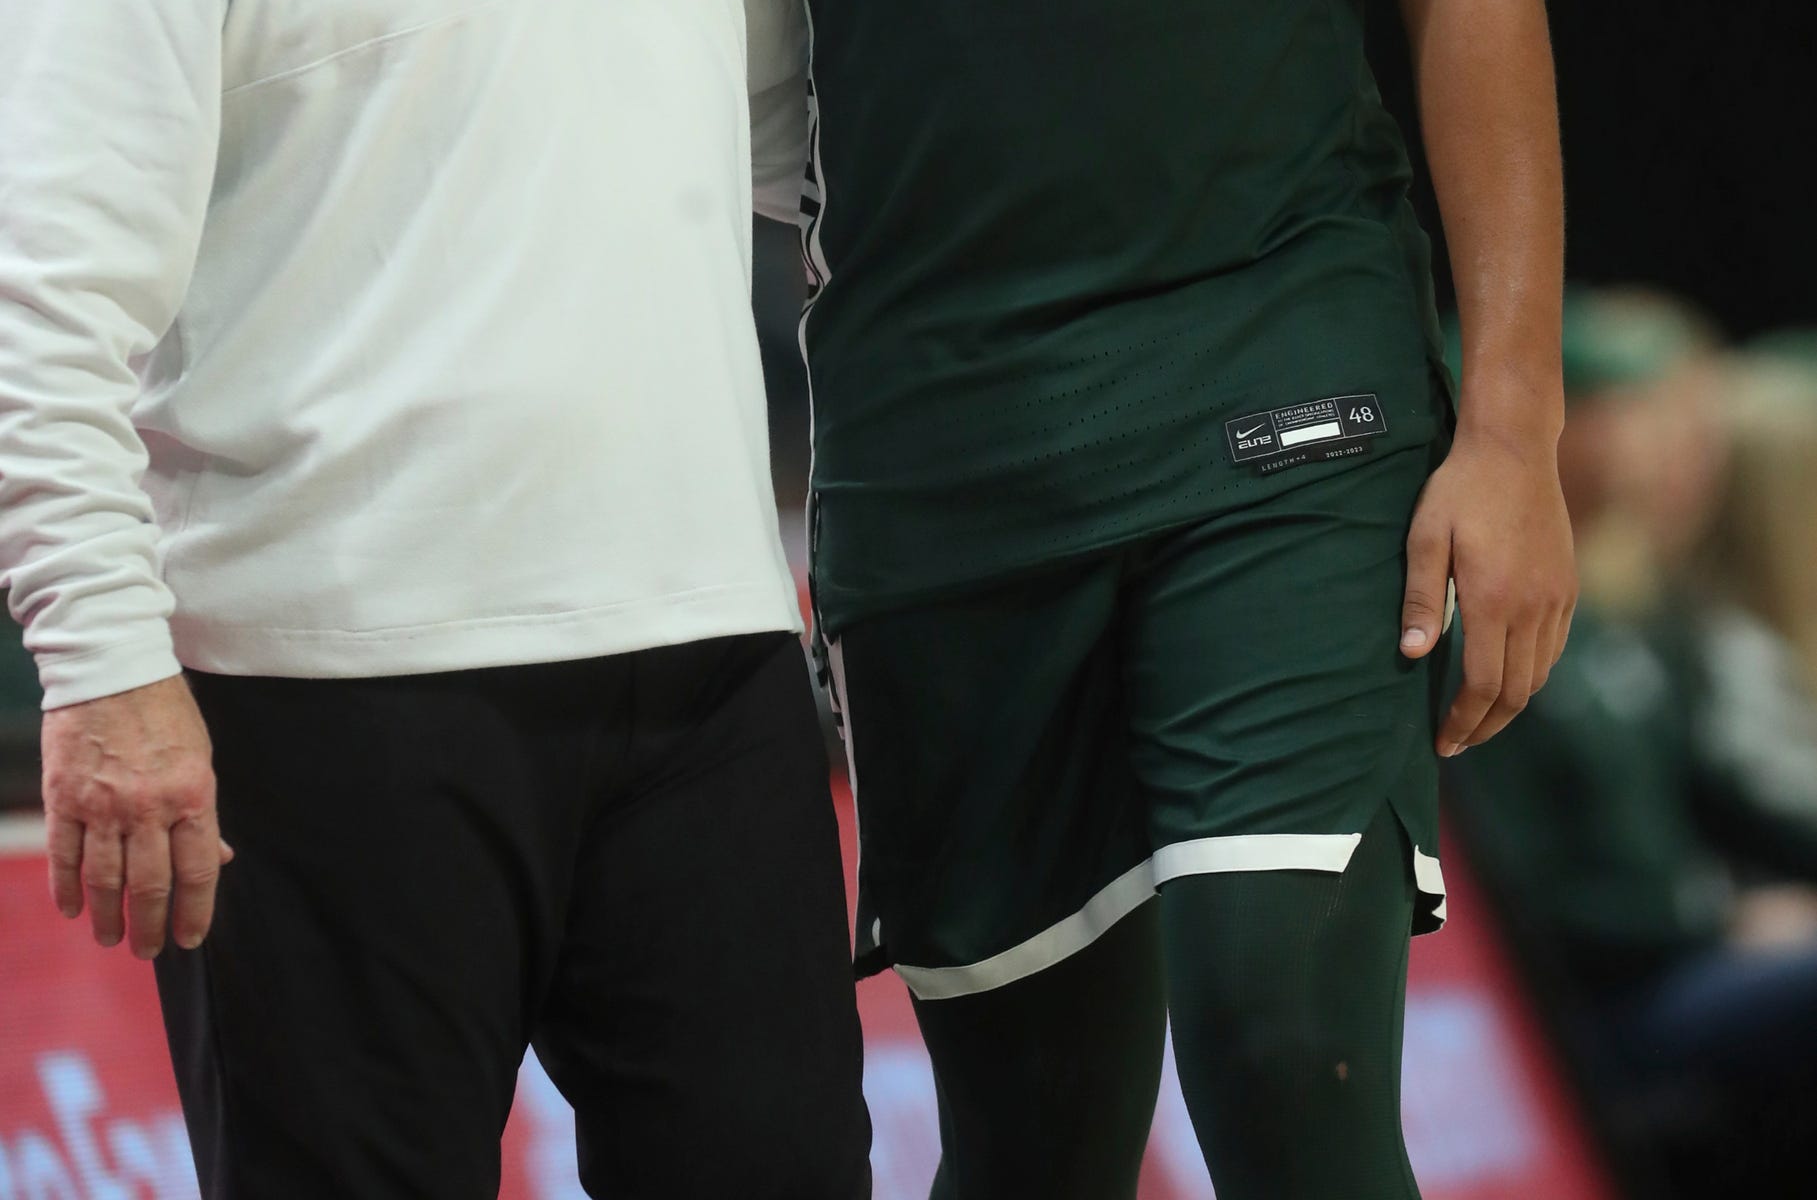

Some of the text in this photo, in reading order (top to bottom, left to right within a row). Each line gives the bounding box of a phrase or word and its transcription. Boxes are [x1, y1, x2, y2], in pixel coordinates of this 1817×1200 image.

[1274, 402, 1333, 420] ENGINEERED
[1348, 406, 1375, 424] 48
[1237, 434, 1272, 450] ELITE
